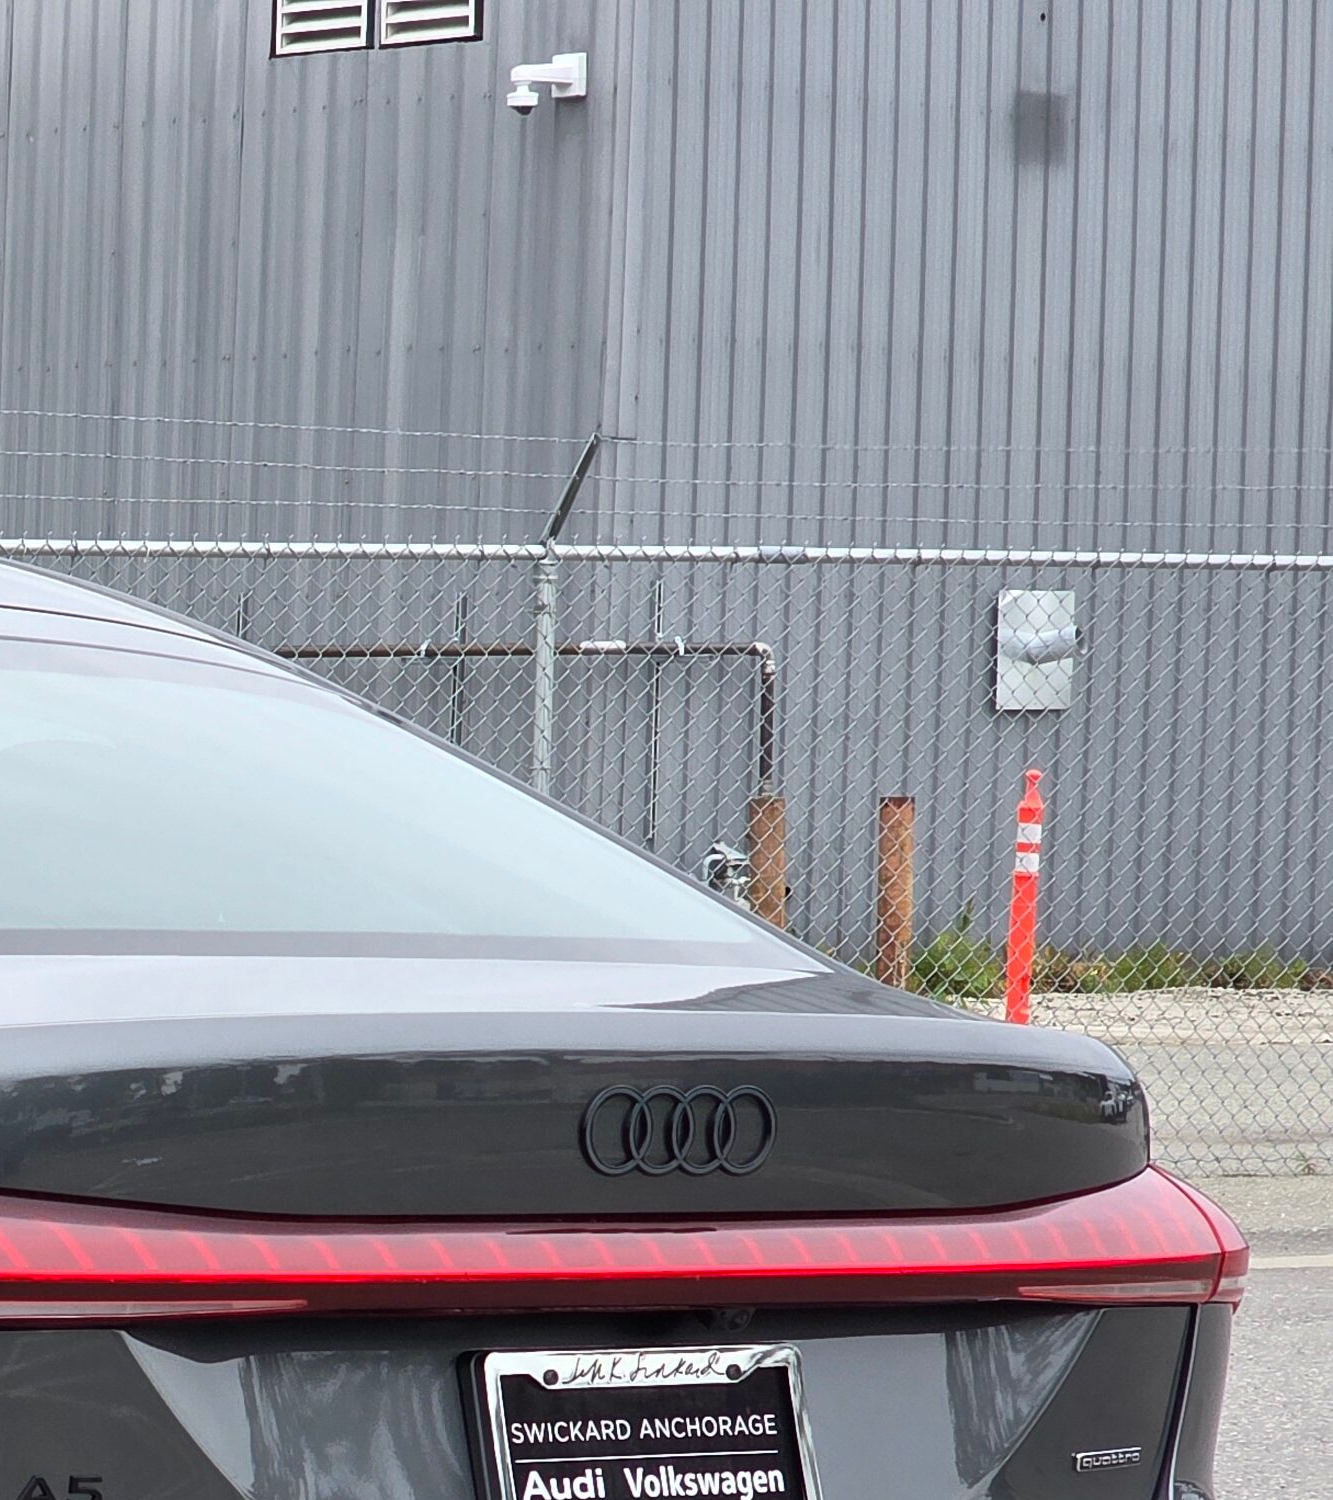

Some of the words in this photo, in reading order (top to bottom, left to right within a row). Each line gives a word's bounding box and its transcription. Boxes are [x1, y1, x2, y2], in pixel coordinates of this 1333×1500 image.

[511, 1418, 631, 1444] SWICKARD
[639, 1413, 778, 1440] ANCHORAGE
[1083, 1452, 1140, 1468] quattro
